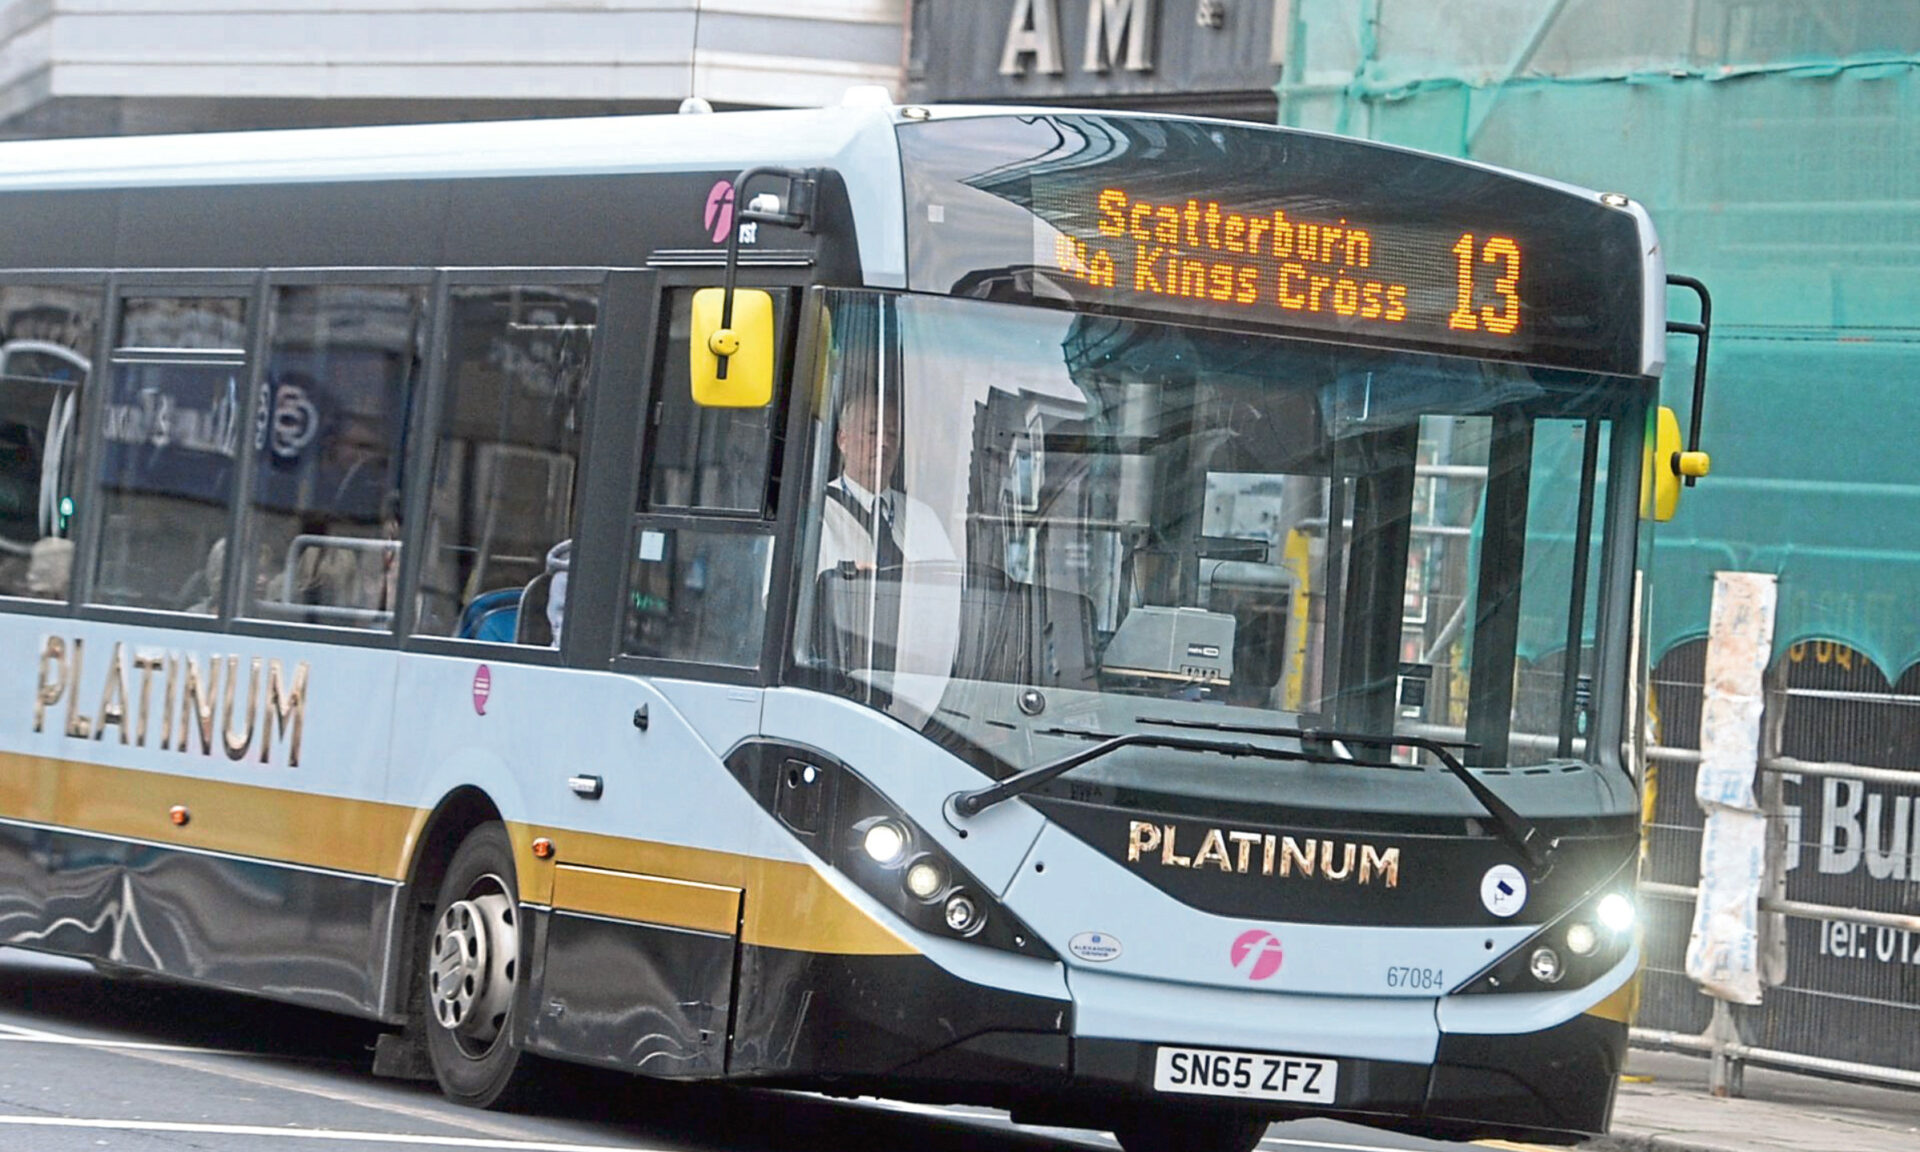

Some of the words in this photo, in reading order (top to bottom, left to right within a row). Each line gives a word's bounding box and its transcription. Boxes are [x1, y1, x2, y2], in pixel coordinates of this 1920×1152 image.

[1098, 188, 1372, 268] Scatterburn
[1134, 244, 1258, 303] Kings
[1277, 261, 1407, 321] Cross
[1450, 232, 1521, 334] 13
[33, 635, 311, 768] PLATINUM
[1127, 820, 1400, 888] PLATINUM
[1387, 965, 1444, 990] 67084
[1170, 1052, 1252, 1092] SN65
[1261, 1059, 1324, 1095] ZFZ
